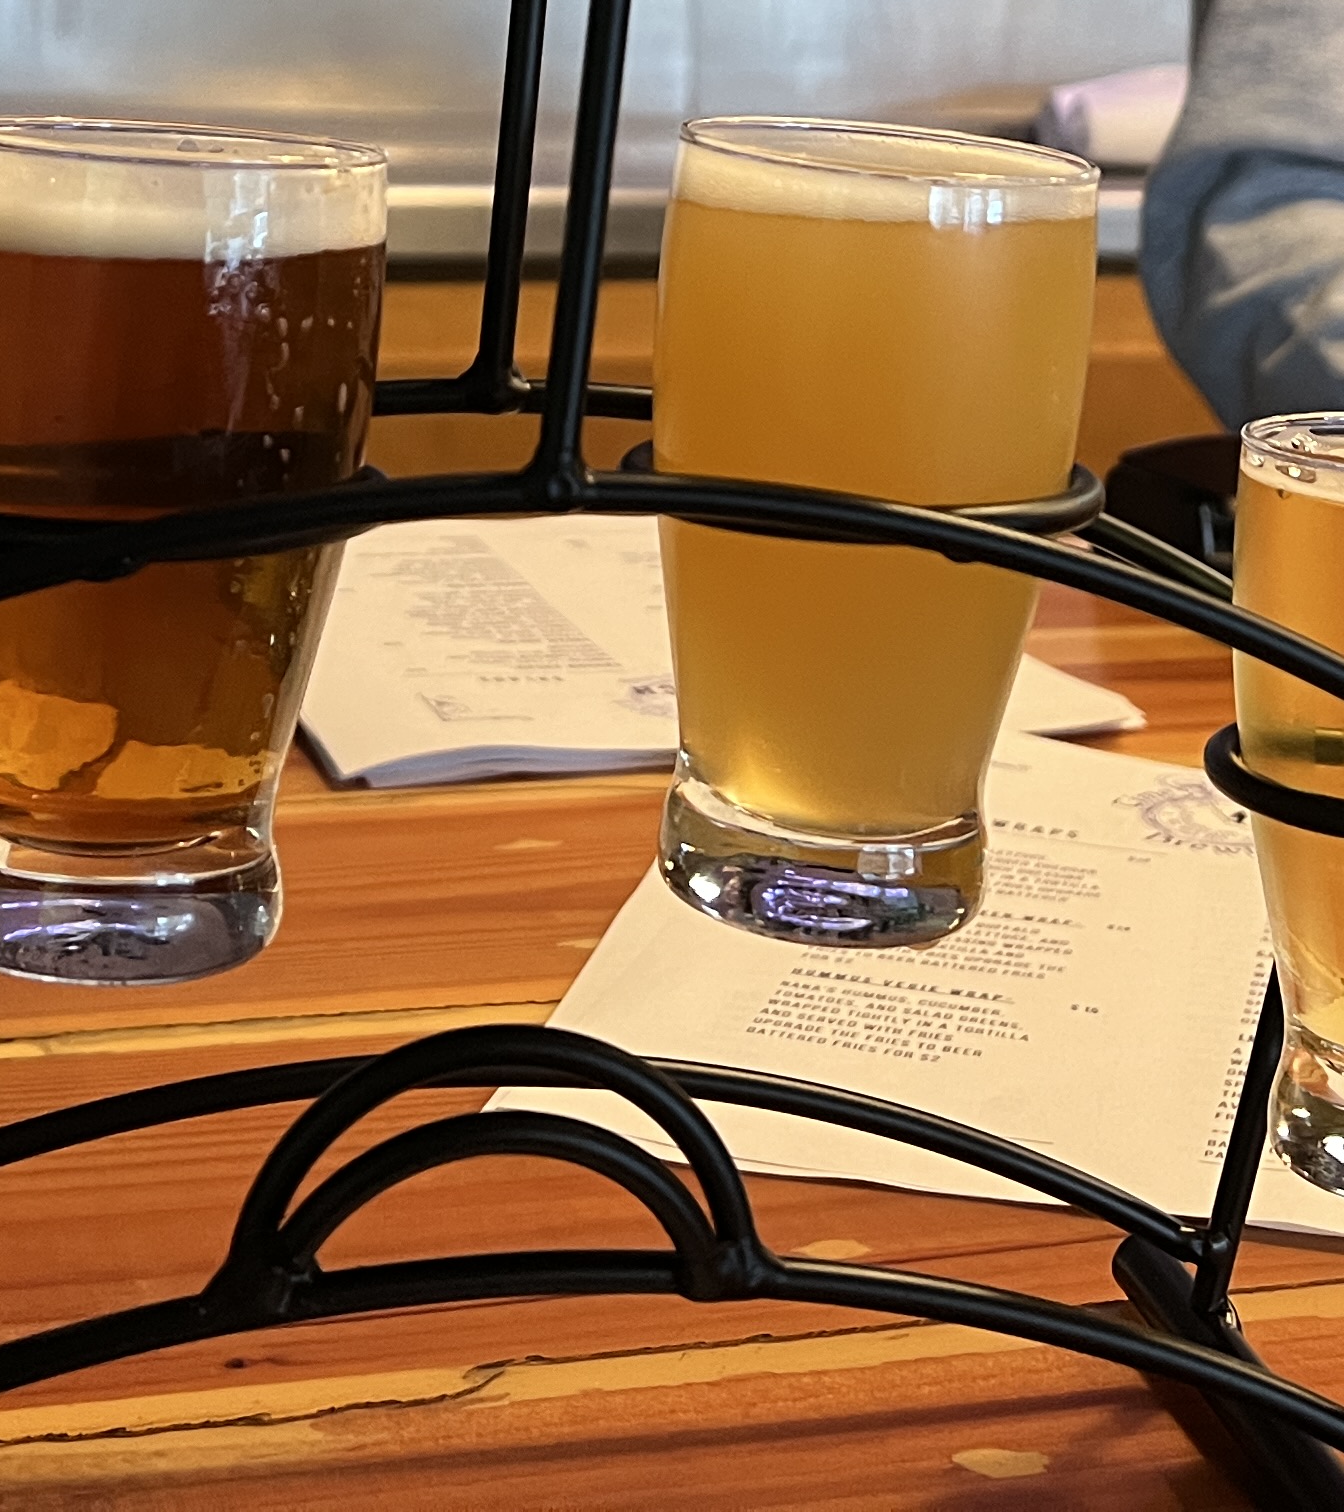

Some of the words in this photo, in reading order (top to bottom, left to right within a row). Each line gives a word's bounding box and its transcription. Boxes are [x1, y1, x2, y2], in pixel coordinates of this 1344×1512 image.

[790, 967, 871, 984] HUMMUS
[950, 989, 1003, 1001] WRAP
[760, 1007, 792, 1018] AND
[797, 1012, 858, 1028] SERVED
[863, 1023, 904, 1035] WITH
[908, 1028, 954, 1042] FRIES
[768, 998, 841, 1014] WRAPPED
[848, 1009, 912, 1025] TIGHTLY
[916, 1020, 934, 1028] IN
[938, 1022, 948, 1030] A
[957, 1024, 1030, 1042] TORTILLA
[865, 1002, 897, 1012] AND
[902, 1007, 954, 1020] SALAD
[745, 1026, 827, 1044] BATTERED
[831, 1039, 878, 1053] FRIES
[883, 1048, 914, 1059] FOR
[920, 1052, 941, 1063] $2
[752, 1016, 824, 1033] UPGRADE
[831, 1028, 860, 1039] THE
[864, 1034, 911, 1047] FRIES
[918, 1041, 937, 1051] TO
[942, 1045, 983, 1057] BEER
